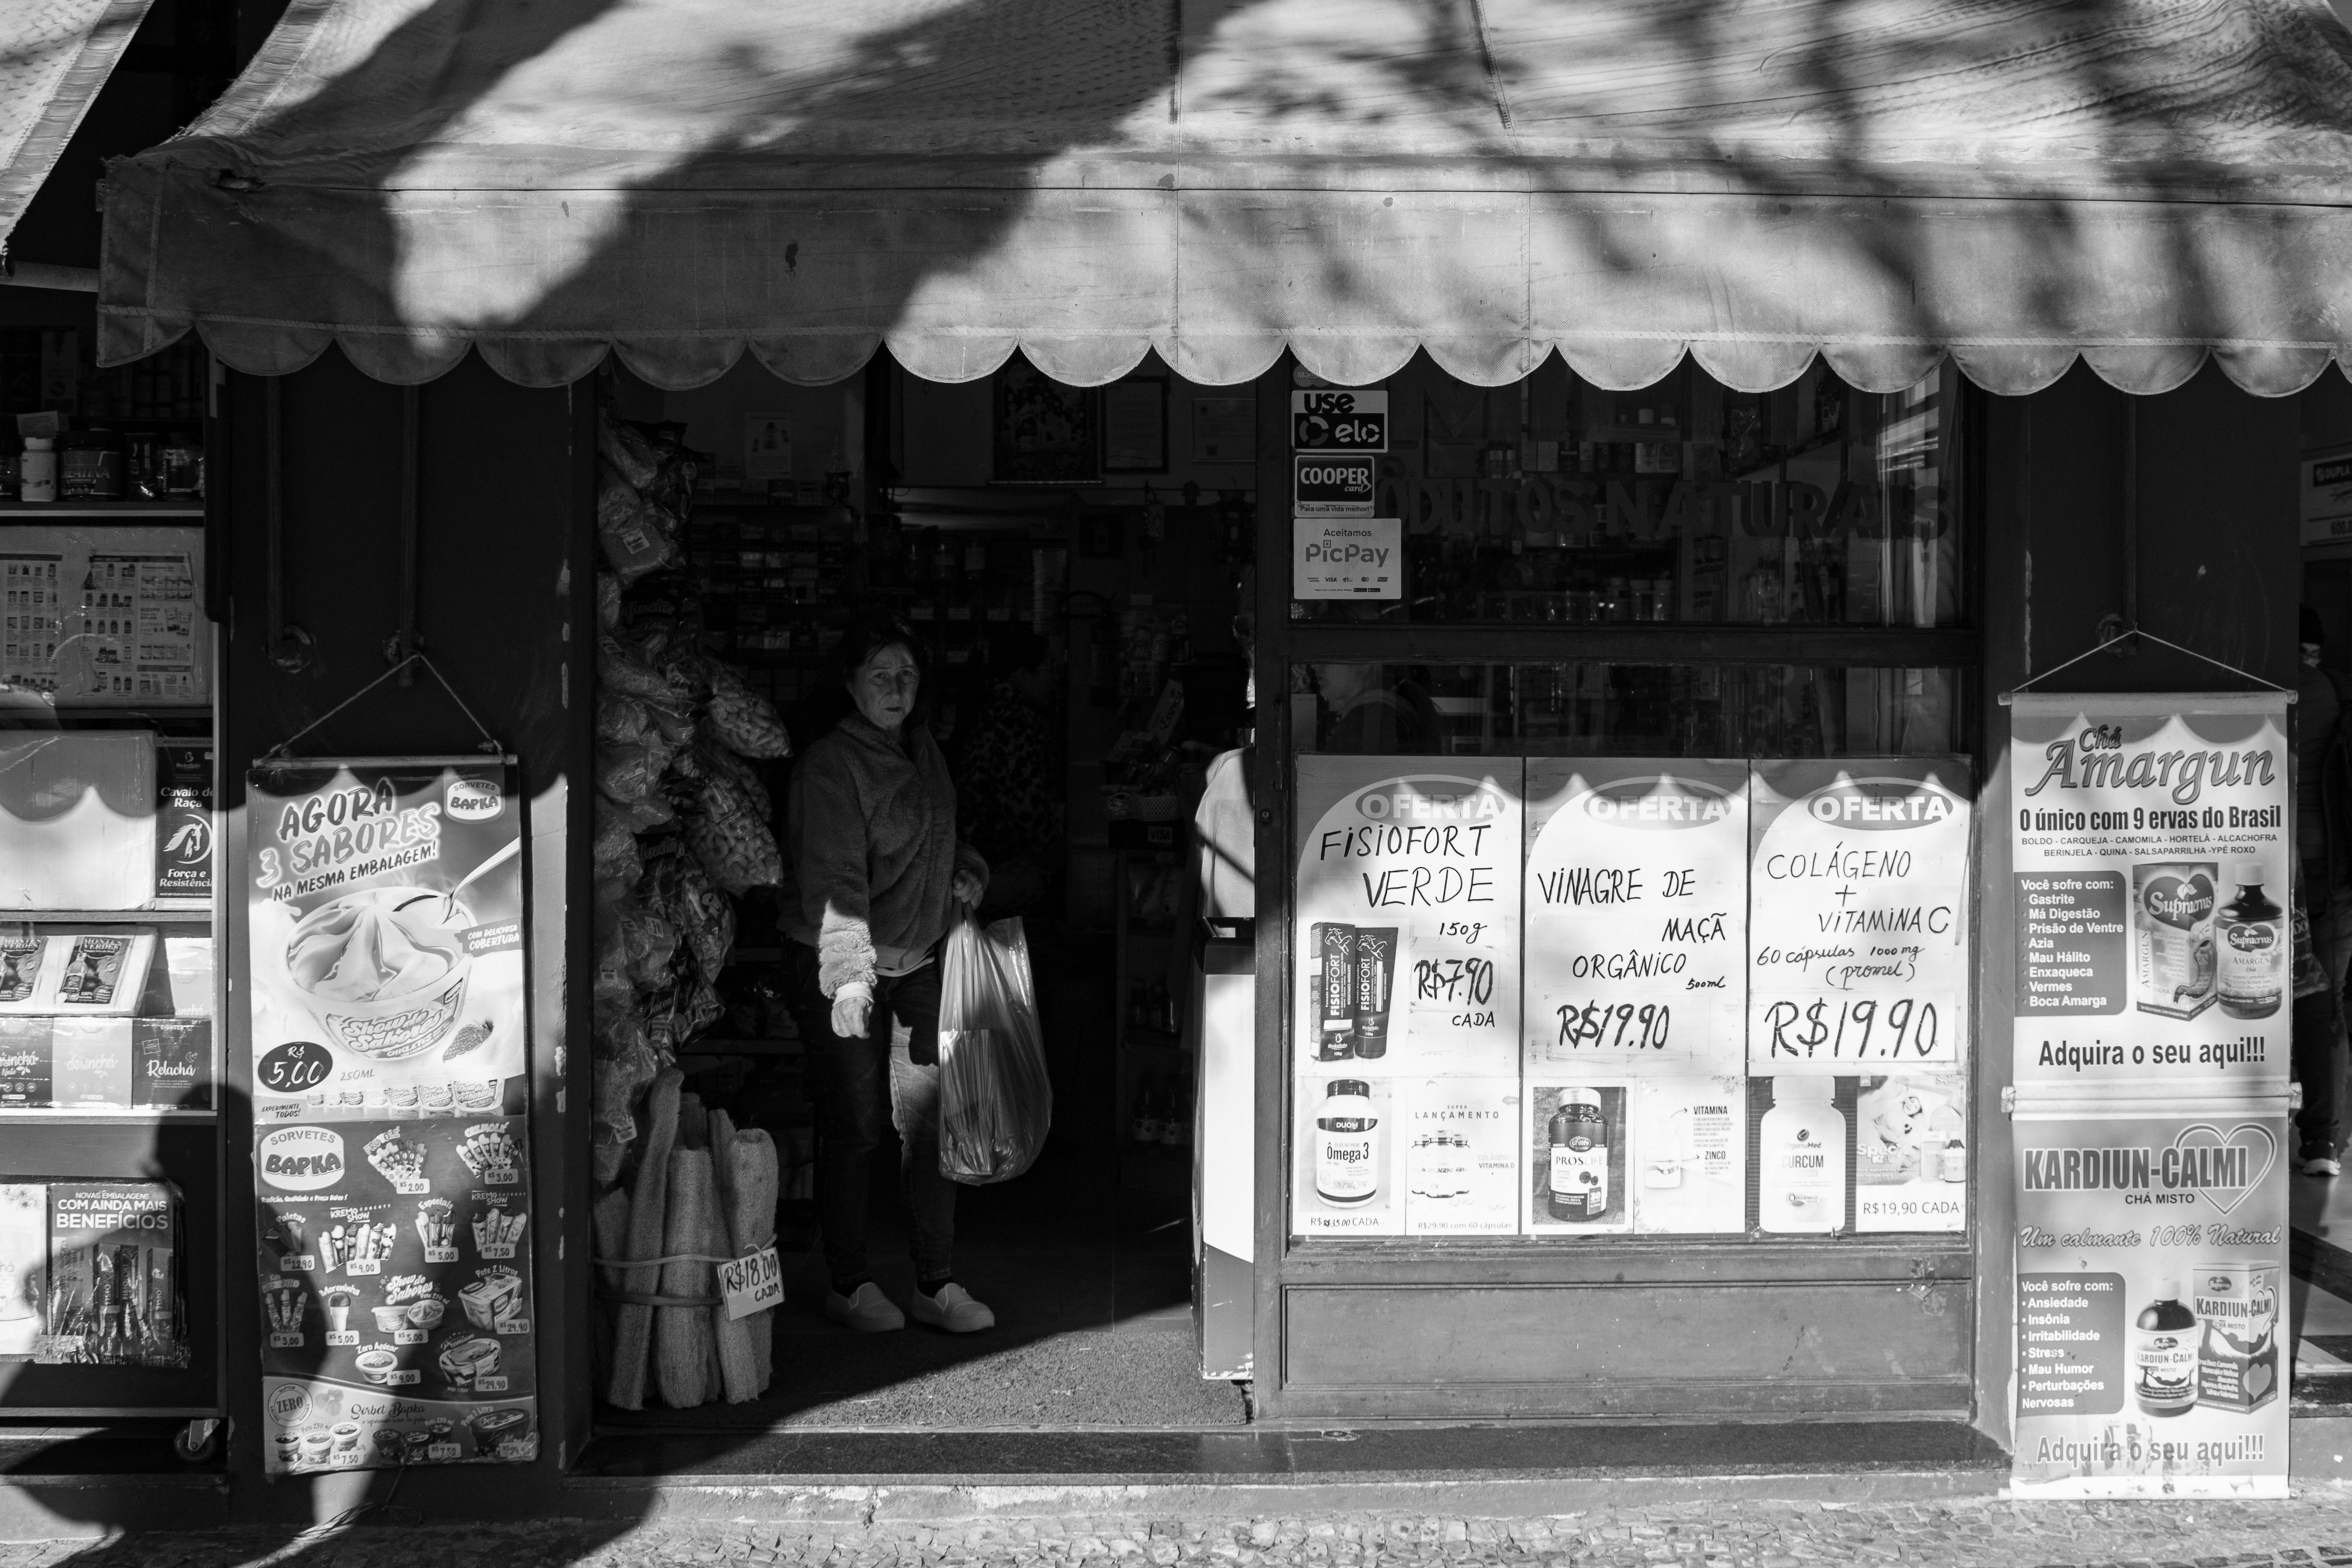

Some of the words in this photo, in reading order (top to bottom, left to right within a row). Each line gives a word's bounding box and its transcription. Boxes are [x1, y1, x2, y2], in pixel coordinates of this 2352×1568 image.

[1335, 419, 1380, 443] elo
[1300, 467, 1369, 484] COOPER
[1344, 484, 1365, 493] card
[1324, 529, 1372, 537] Aceitamos
[1306, 540, 1389, 568] PicPay
[2079, 724, 2122, 751] Chá
[2025, 738, 2275, 805] Amargun
[160, 787, 198, 797] Cavalo
[454, 780, 497, 791] SORVETES
[174, 798, 202, 809] Raça
[278, 778, 394, 840] AGORA
[450, 794, 499, 810] BAPKA
[1362, 794, 1497, 819] OFERTA
[1588, 796, 1729, 820] OFERTA
[1813, 796, 1950, 821] OFERTA
[2020, 809, 2030, 832] O
[2036, 807, 2086, 831] único
[2090, 810, 2128, 830] com
[2134, 807, 2144, 830] 9
[2149, 810, 2198, 830] ervas
[2203, 806, 2224, 829] do
[2229, 805, 2281, 828] Brasil
[257, 850, 280, 885] 3
[292, 805, 440, 873] SABORES
[2022, 837, 2052, 845] BOLDO
[2061, 836, 2108, 845] CARQUEJA
[2116, 835, 2162, 844] CAMOMILA
[2169, 833, 2210, 842] HORTELÃ
[2218, 834, 2277, 842] ALCACHOFRA
[1767, 841, 1911, 879] COLÁGENO
[167, 869, 197, 878] Força
[274, 884, 292, 901] NA
[296, 871, 345, 894] MESMA
[350, 841, 437, 880] EMBALAGEM!
[1363, 866, 1494, 908] VERDE
[1663, 869, 1695, 898] DE
[2022, 879, 2050, 890] Você
[2053, 879, 2082, 890] sofre
[2086, 880, 2114, 890] com:
[1836, 884, 1857, 907] +
[2029, 894, 2075, 905] Gastrite
[1929, 906, 1951, 934] C
[2029, 907, 2047, 919] Má
[2049, 908, 2100, 921] Digestão
[1439, 922, 1488, 944] 150g
[1662, 912, 1727, 943] MAÇÃ
[2029, 922, 2067, 934] Prisão
[2069, 923, 2084, 933] de
[2086, 922, 2124, 933] Ventre
[84, 943, 119, 951] VERDES
[469, 932, 520, 951] COBERTURA
[2029, 937, 2054, 948] Azia
[1757, 946, 1780, 965] 60
[1786, 945, 1855, 972] cápsulas
[2029, 953, 2054, 963] Mau
[2057, 951, 2090, 962] Hálito
[2029, 967, 2093, 979] Enxaqueca
[1330, 954, 1340, 1016] FISIOFORT
[1361, 957, 1370, 1010] FISIOFORT
[2029, 981, 2072, 992] Vermes
[2029, 996, 2059, 1006] Boca
[2061, 996, 2107, 1007] Amarga
[1452, 1011, 1496, 1028] CADA
[288, 1044, 305, 1059] R$
[2039, 1040, 2124, 1071] Adquira
[2132, 1044, 2144, 1064] o
[2153, 1043, 2191, 1064] seu
[2199, 1036, 2265, 1069] aqui!!!
[146, 1059, 195, 1078] Relachá
[269, 1059, 324, 1088] 5,00
[262, 1103, 300, 1112] EXPERIMENTE
[276, 1108, 301, 1118] TODOS!
[1694, 1106, 1727, 1115] VITAMINA
[1415, 1111, 1499, 1121] LANÇAMENTO
[270, 1130, 336, 1146] SORVETES
[1327, 1142, 1361, 1164] Ômega
[1363, 1142, 1369, 1159] 3
[1705, 1151, 1726, 1160] ZINCO
[266, 1152, 344, 1175] BAPKA
[2024, 1146, 2248, 1191] KARDIUN-CALMI
[102, 1192, 150, 1200] EMBALAGENS
[417, 1197, 454, 1210] Especiais
[472, 1192, 497, 1200] KREMO
[2125, 1191, 2152, 1204] CHÁ
[2156, 1194, 2195, 1204] MISTO
[58, 1199, 88, 1211] COM
[90, 1200, 132, 1211] AINDA
[134, 1200, 167, 1211] MAIS
[1863, 1202, 1917, 1216] R$19,90
[1922, 1202, 1960, 1214] CADA
[56, 1211, 169, 1230] BENEFÍCIOS
[330, 1208, 358, 1219] KREMO
[347, 1211, 370, 1223] SHOW
[2020, 1226, 2056, 1247] Um
[2061, 1227, 2141, 1247] calmante
[2149, 1224, 2202, 1247] 100%
[2207, 1224, 2282, 1245] Natural
[386, 1274, 417, 1292] Show
[414, 1274, 426, 1286] de
[2022, 1281, 2049, 1291] Você
[2051, 1281, 2081, 1291] sofre
[2085, 1281, 2113, 1291] com:
[319, 1284, 360, 1301] Moreninha
[385, 1281, 433, 1305] Sabores
[754, 1283, 780, 1302] CADA
[2028, 1298, 2088, 1308] Ansiedade
[2029, 1314, 2070, 1325] Insônia
[441, 1334, 475, 1350] Premium
[2029, 1330, 2100, 1341] Irritabilidade
[356, 1344, 372, 1354] Zero
[374, 1341, 399, 1353] Açúcar
[2029, 1348, 2064, 1358] Stress
[2029, 1364, 2053, 1374] Mau
[2054, 1364, 2094, 1374] Humor
[2029, 1380, 2104, 1393] Perturbações
[276, 1396, 303, 1414] ZERO
[2022, 1397, 2074, 1408] Nervosas
[2037, 1436, 2121, 1469] Adquira
[2130, 1441, 2142, 1461] o
[2150, 1441, 2189, 1461] seu
[2196, 1434, 2264, 1467] aqui!!!
